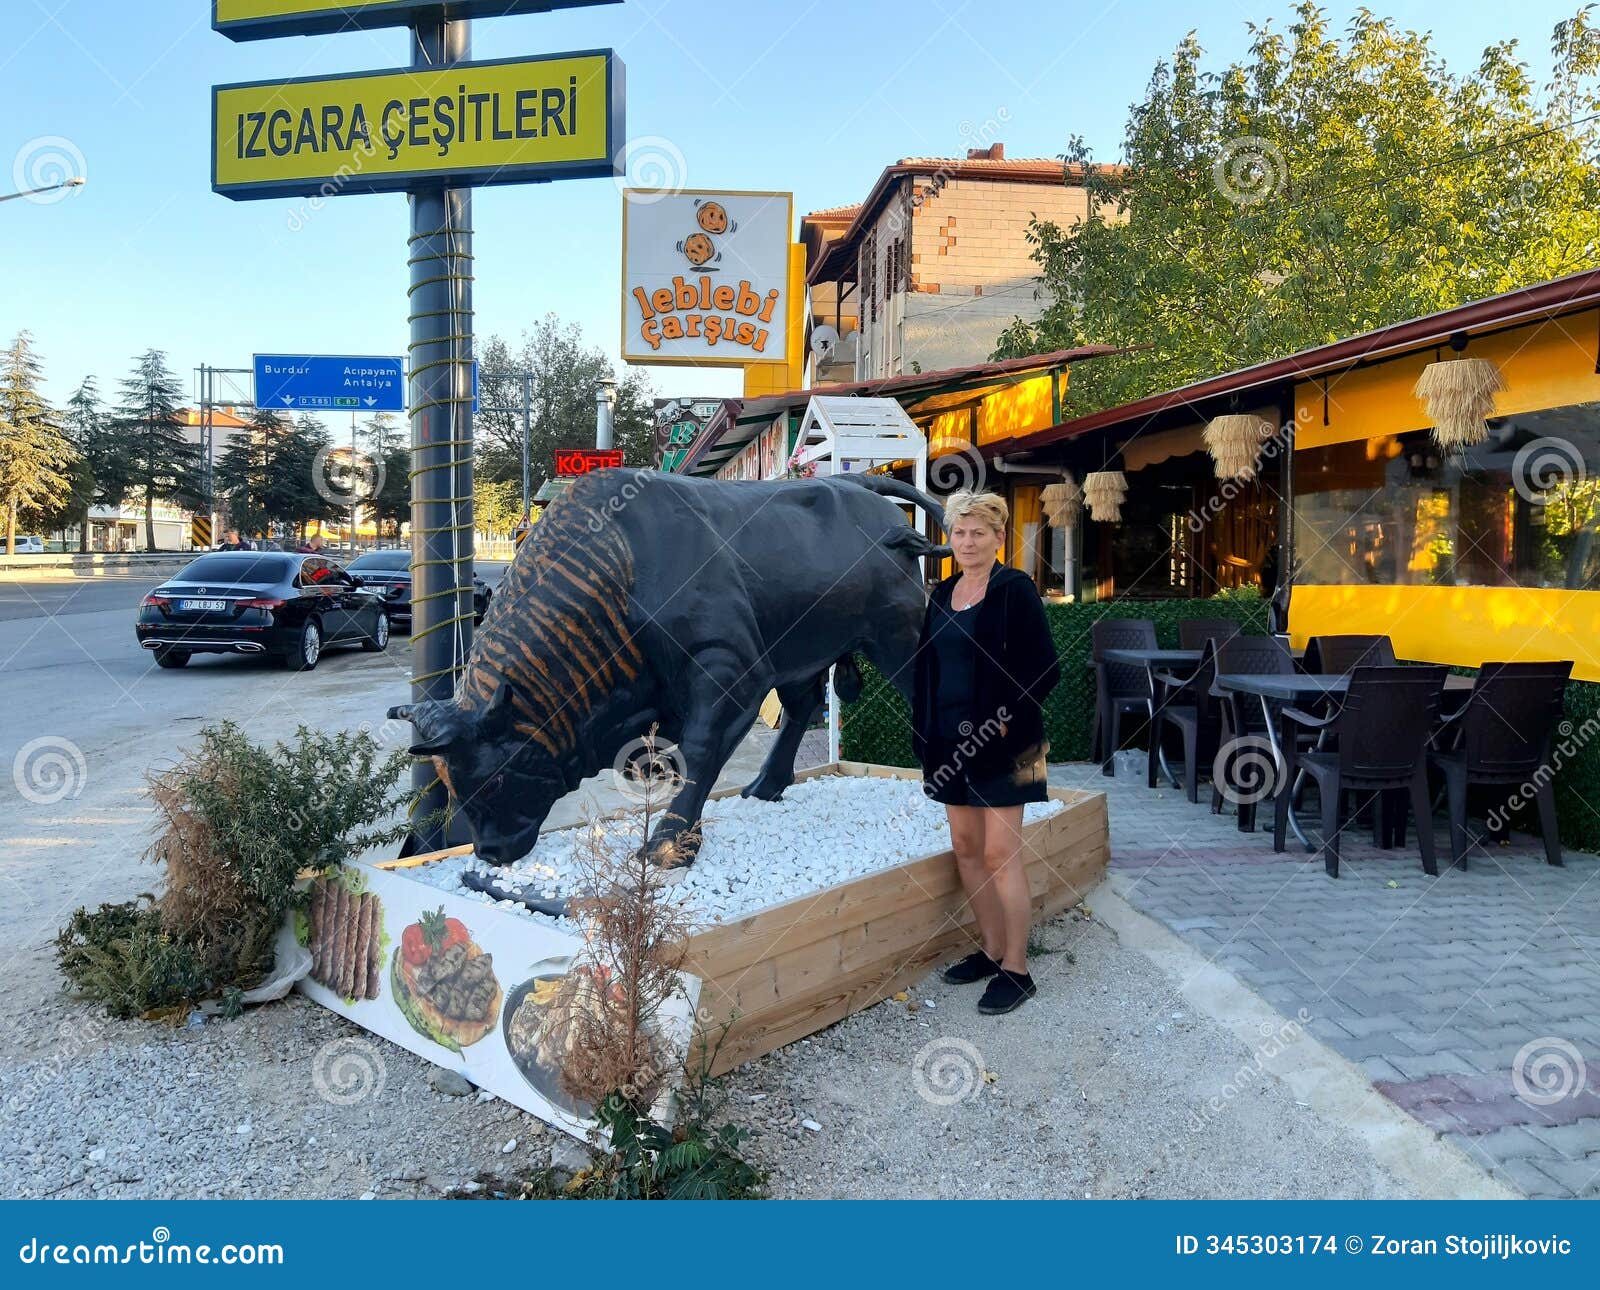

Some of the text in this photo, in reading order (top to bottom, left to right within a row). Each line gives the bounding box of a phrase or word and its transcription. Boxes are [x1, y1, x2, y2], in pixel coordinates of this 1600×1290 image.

[237, 76, 577, 161] IZGARA ÇEŞİTLERİ
[633, 276, 779, 323] leblebi
[641, 314, 769, 352] çarşısı
[264, 364, 310, 375] Burdur
[343, 366, 397, 377] Acıpayam
[343, 377, 392, 389] Antalya
[558, 452, 620, 474] KÖFTE
[184, 600, 193, 609] 07
[215, 601, 225, 609] 52
